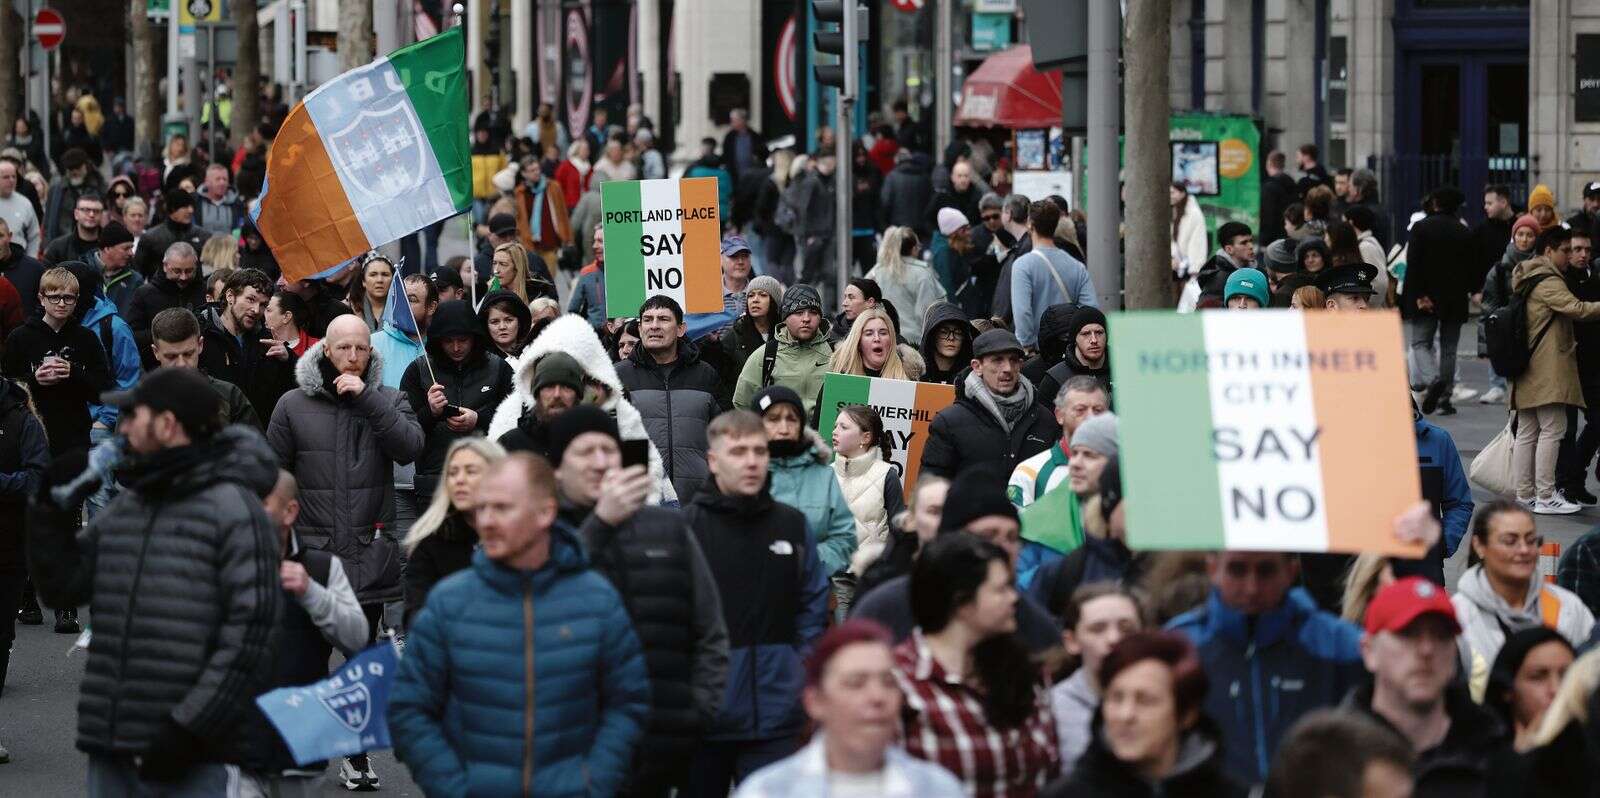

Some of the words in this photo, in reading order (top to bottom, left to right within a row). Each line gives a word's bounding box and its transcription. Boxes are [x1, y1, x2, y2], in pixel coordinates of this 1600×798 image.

[606, 209, 672, 225] PORTLAND
[676, 207, 716, 220] PLACE
[640, 233, 687, 256] SAY
[647, 267, 682, 290] NO
[1138, 349, 1259, 374] NORTH
[1271, 349, 1378, 373] INNER
[1223, 382, 1299, 405] CITY
[1211, 426, 1323, 462] SAY
[1231, 484, 1317, 522] NO
